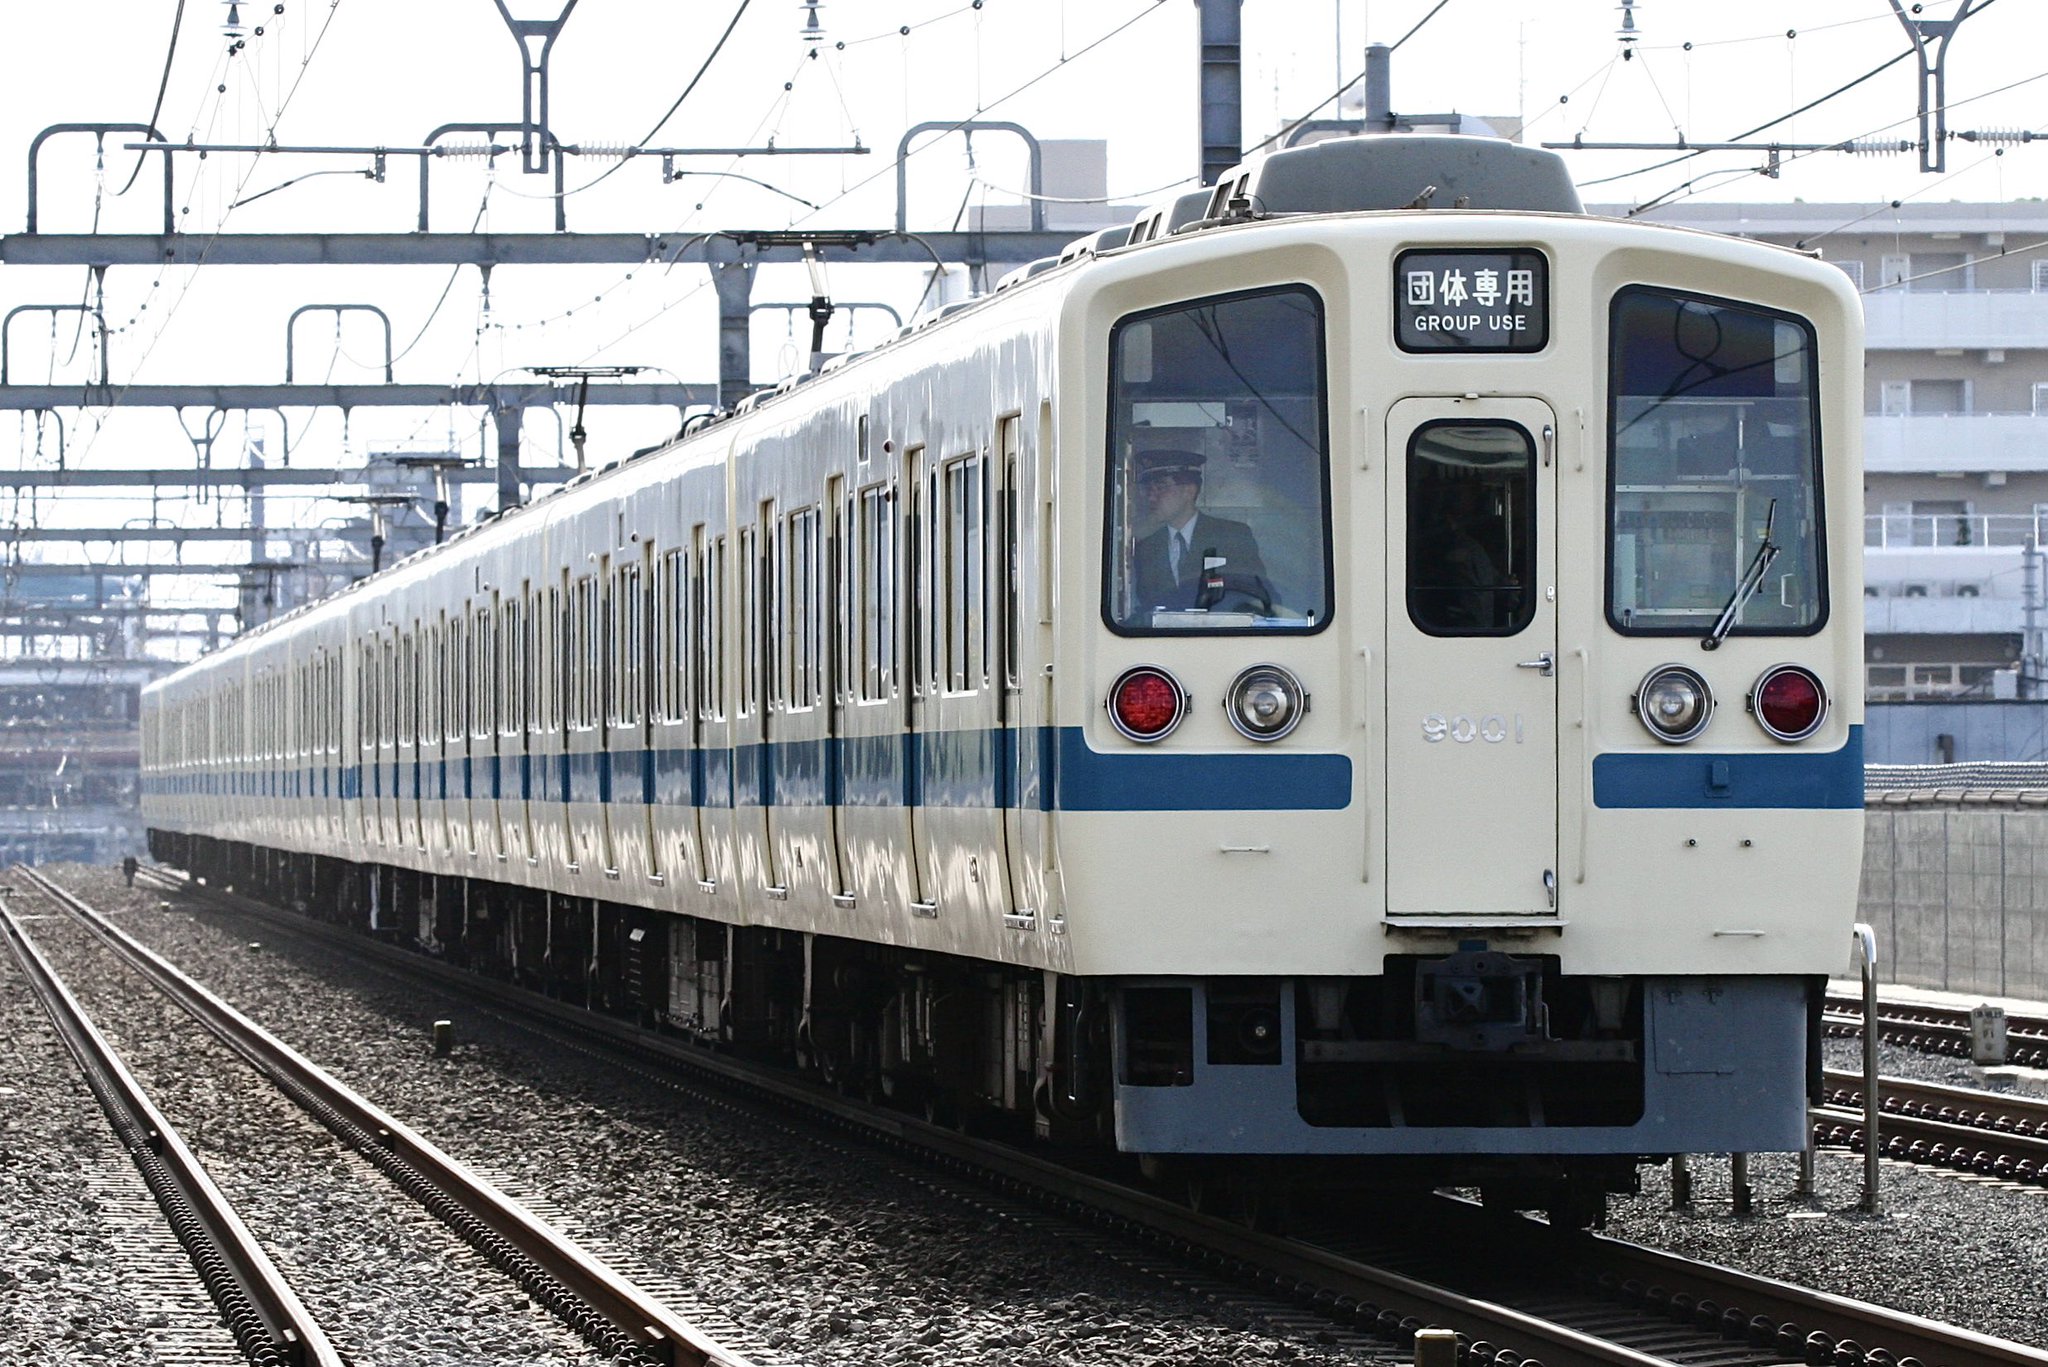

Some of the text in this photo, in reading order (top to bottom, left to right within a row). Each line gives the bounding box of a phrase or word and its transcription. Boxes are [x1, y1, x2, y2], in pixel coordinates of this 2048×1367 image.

[1407, 268, 1533, 307] 団体専用
[1415, 315, 1526, 331] GROUP USE
[1422, 712, 1524, 744] 9001
